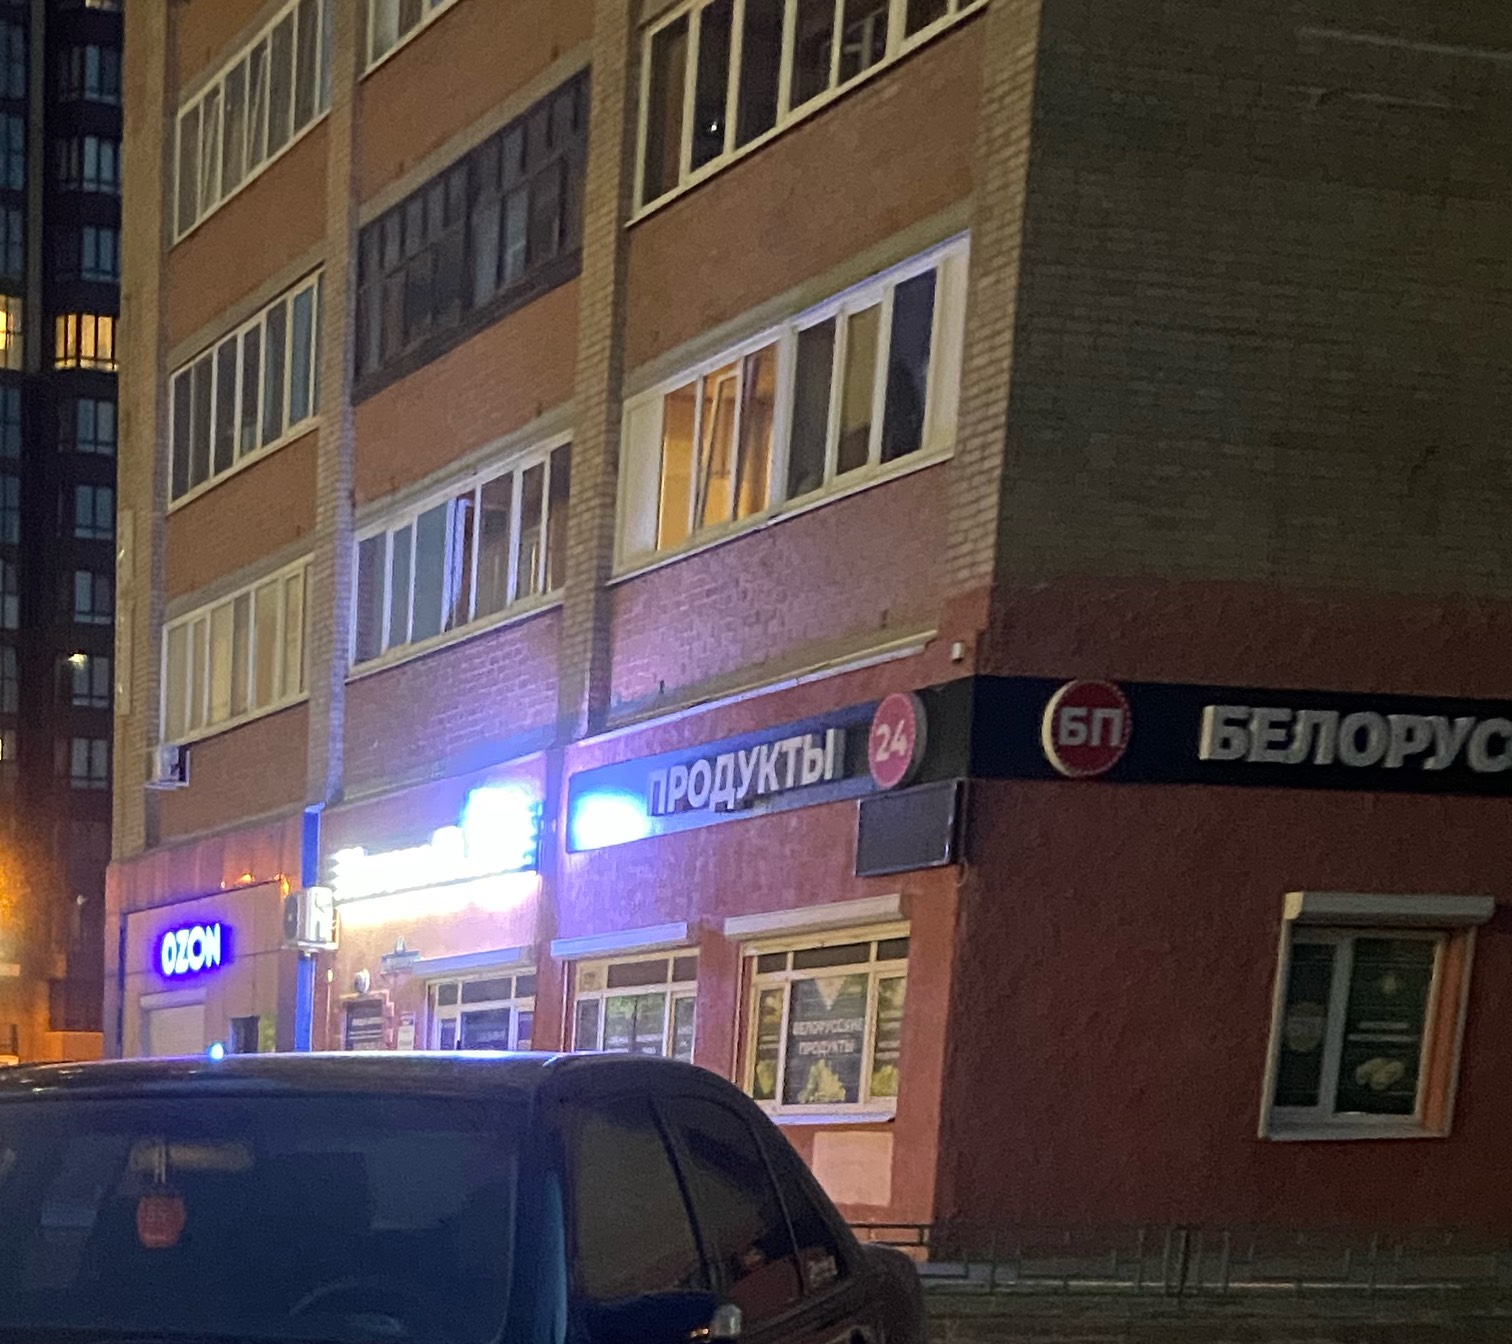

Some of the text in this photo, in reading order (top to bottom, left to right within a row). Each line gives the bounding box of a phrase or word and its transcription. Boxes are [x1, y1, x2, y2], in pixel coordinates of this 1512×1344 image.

[876, 723, 908, 763] 24
[1058, 706, 1123, 747] БП
[1199, 704, 1512, 773] БЕЛОРУС
[647, 728, 835, 816] ПРОДУКТЫ
[161, 922, 222, 976] OZON
